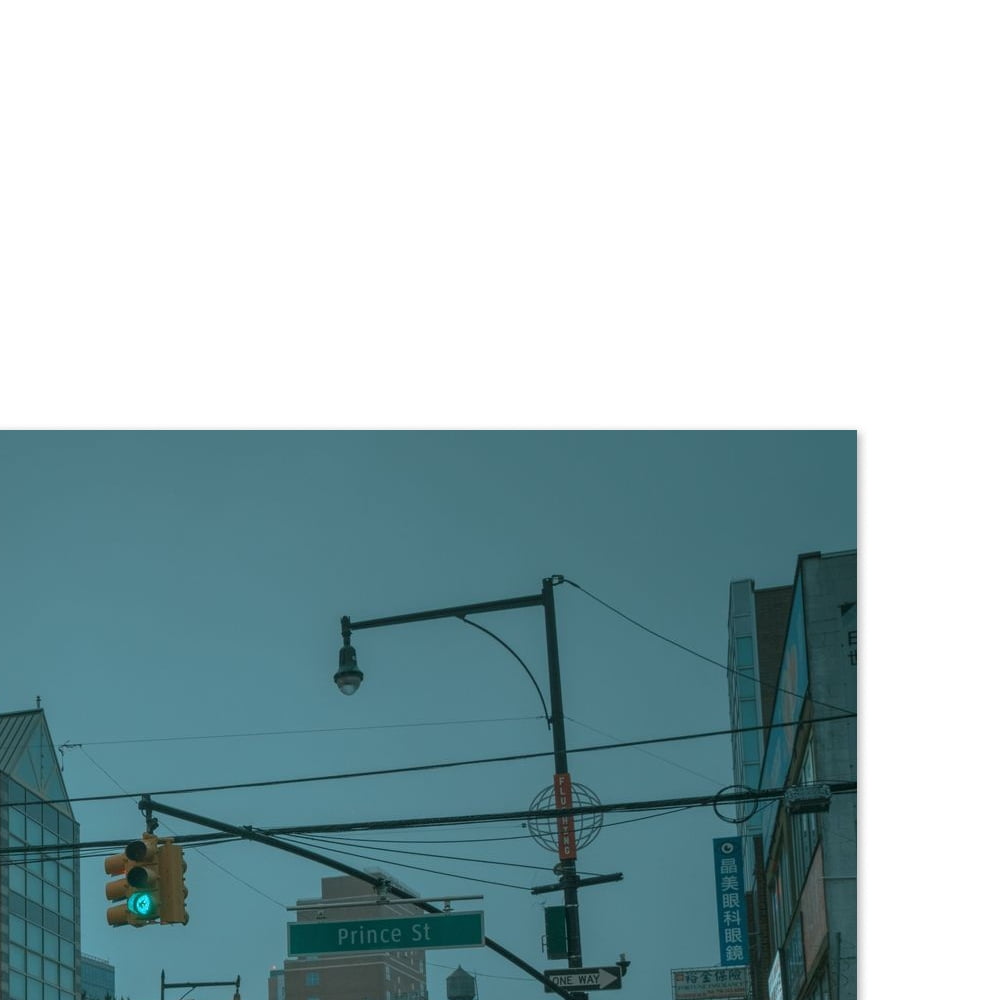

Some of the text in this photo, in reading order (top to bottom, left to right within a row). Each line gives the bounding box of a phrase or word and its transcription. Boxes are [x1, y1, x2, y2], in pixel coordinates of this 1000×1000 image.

[559, 776, 570, 855] FLUHING
[338, 923, 431, 945] Prince St
[721, 858, 744, 961] 晶美眼科眼鏡
[552, 973, 600, 986] ONE WAY
